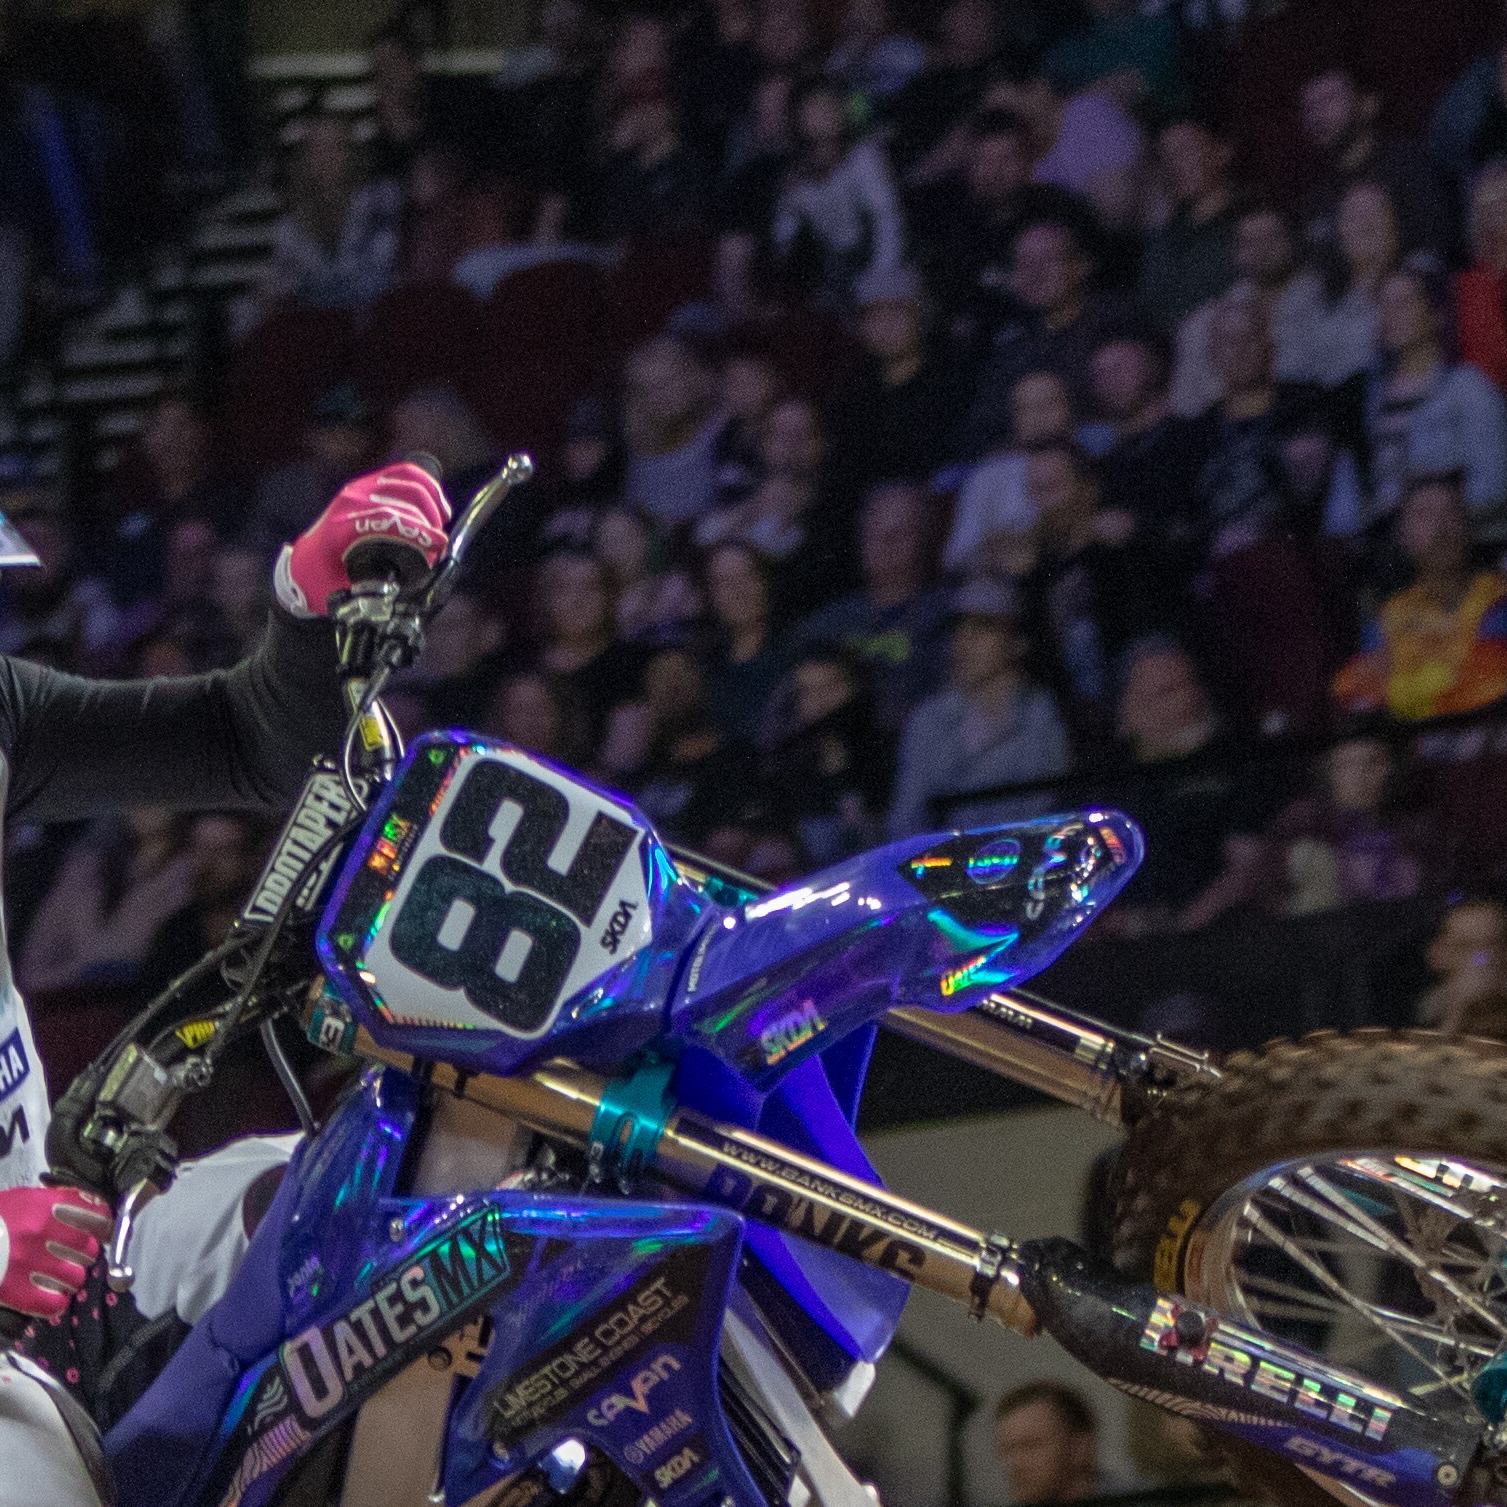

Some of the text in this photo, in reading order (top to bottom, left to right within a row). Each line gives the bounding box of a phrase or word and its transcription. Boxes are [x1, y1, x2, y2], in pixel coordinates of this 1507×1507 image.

[389, 758, 640, 1035] 82
[493, 1335, 601, 1419] LIMESTONE
[592, 1276, 672, 1348] COAST
[1139, 1299, 1392, 1441] RELLI
[1284, 1435, 1396, 1488] GYTR
